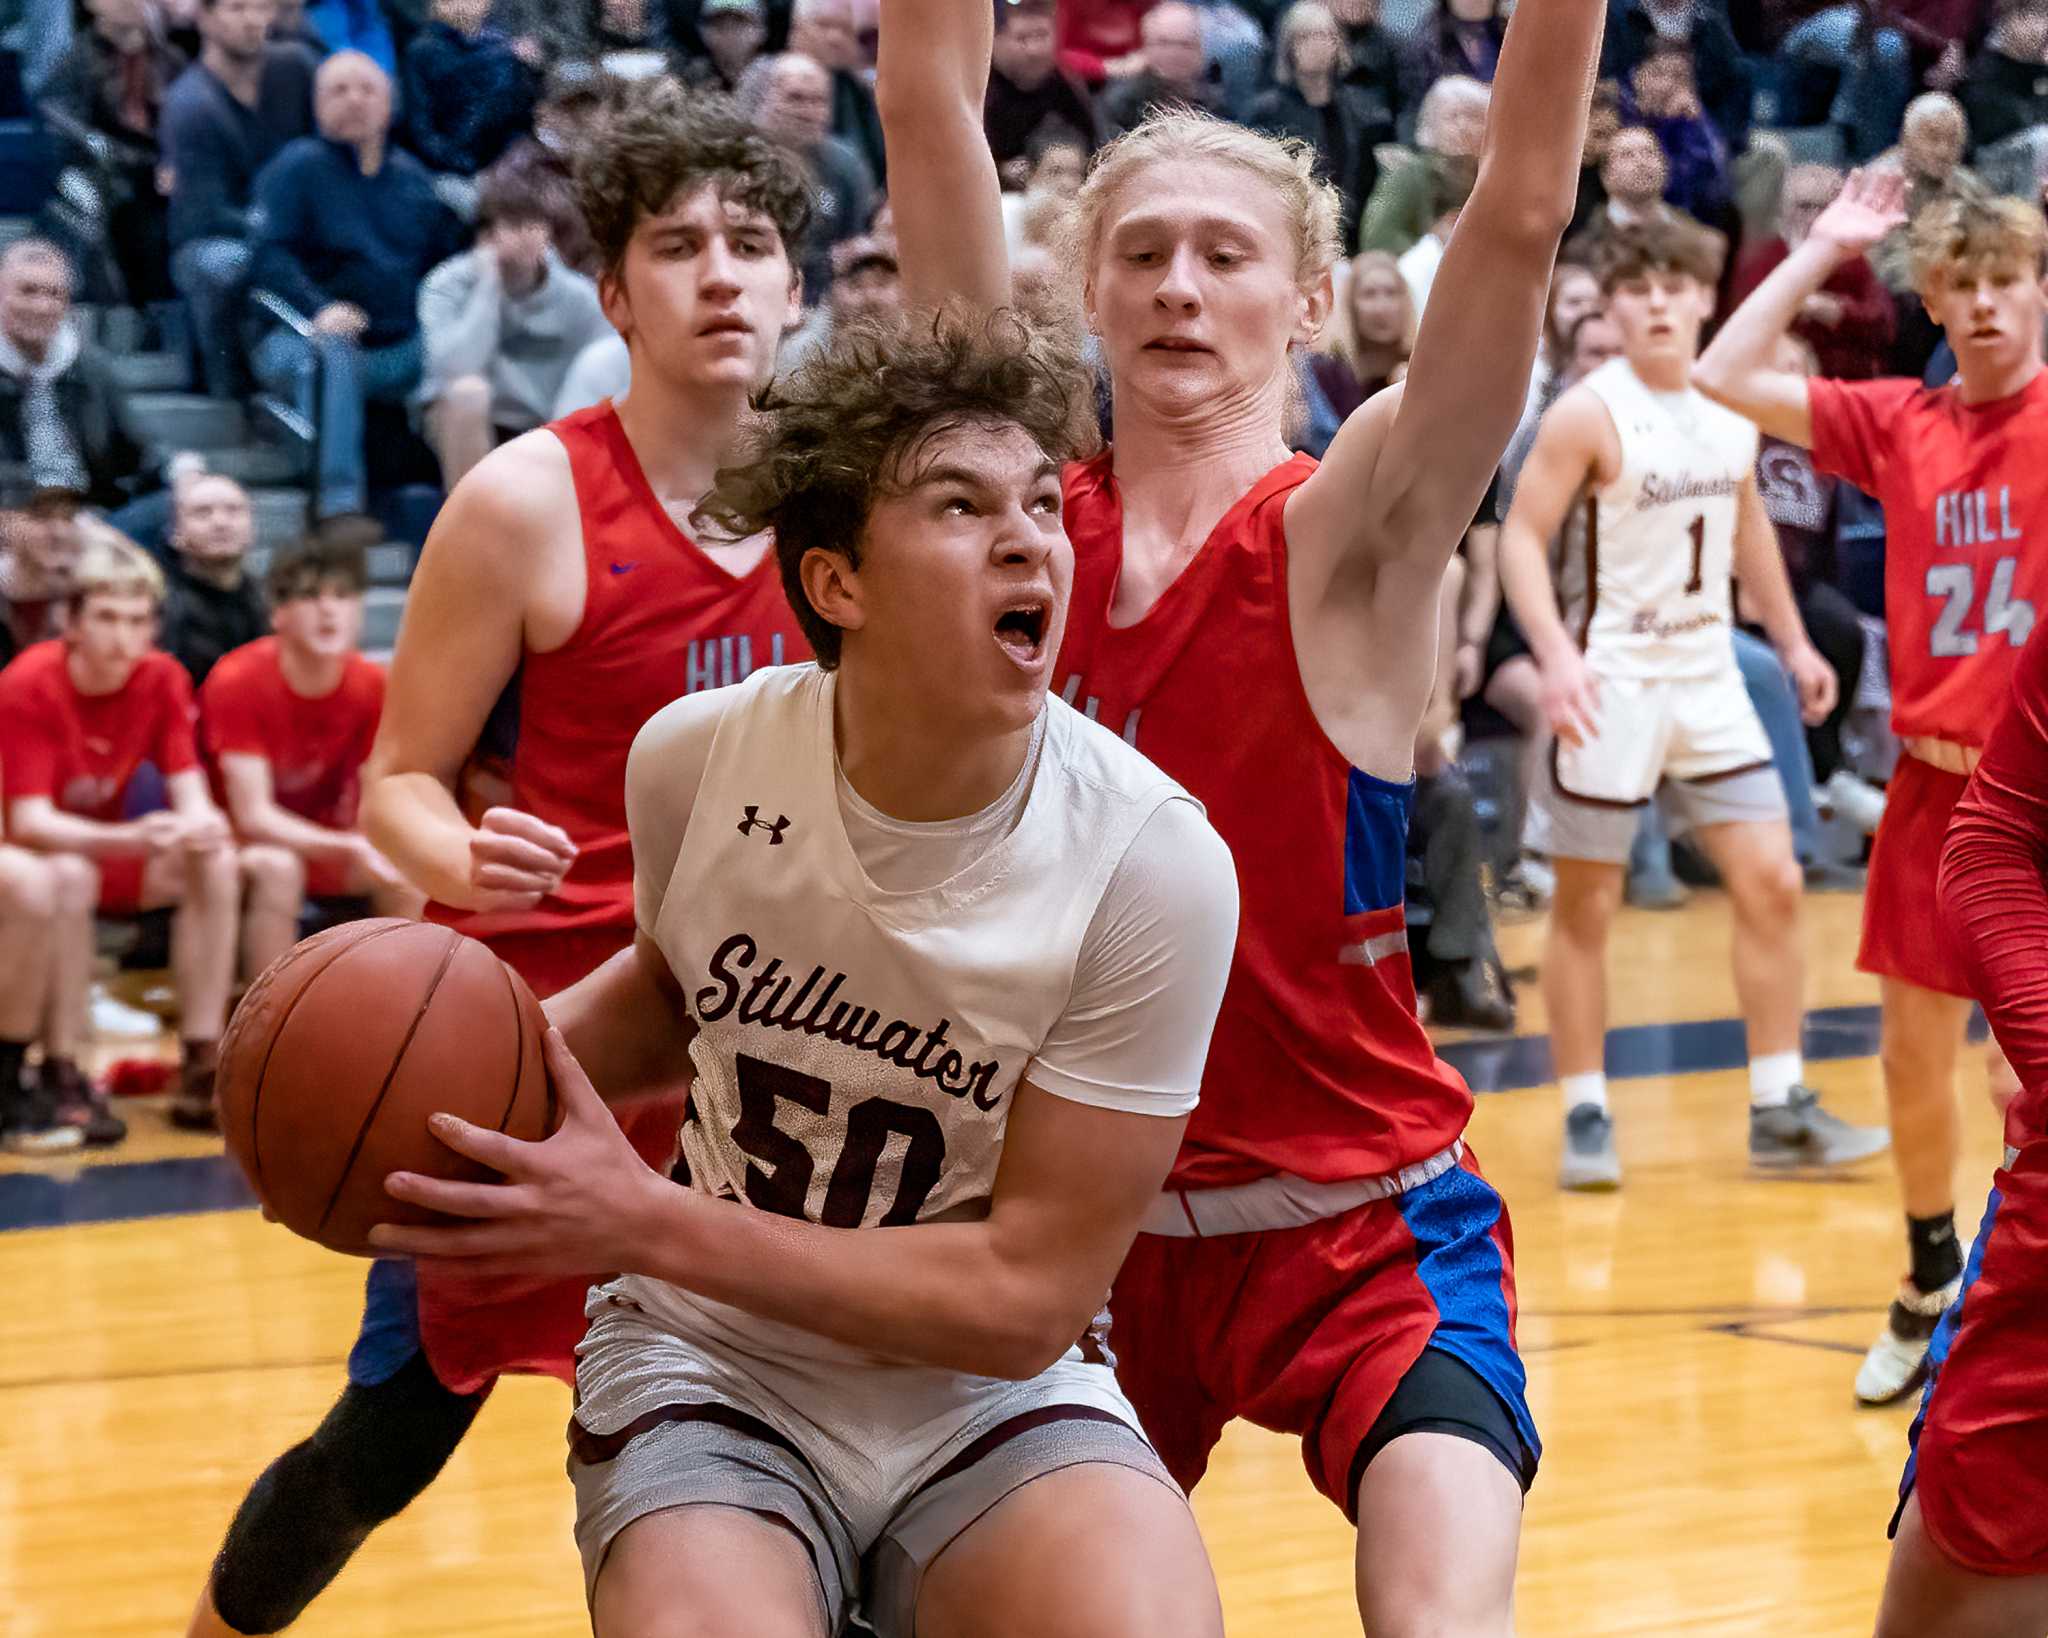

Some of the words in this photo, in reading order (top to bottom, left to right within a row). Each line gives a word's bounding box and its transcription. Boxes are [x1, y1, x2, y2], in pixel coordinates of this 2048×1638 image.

[1684, 513, 1705, 593] 1
[1936, 484, 2022, 546] HILL
[1926, 556, 2036, 657] 24
[696, 933, 1002, 1112] Stillwater
[731, 1053, 946, 1229] 50
